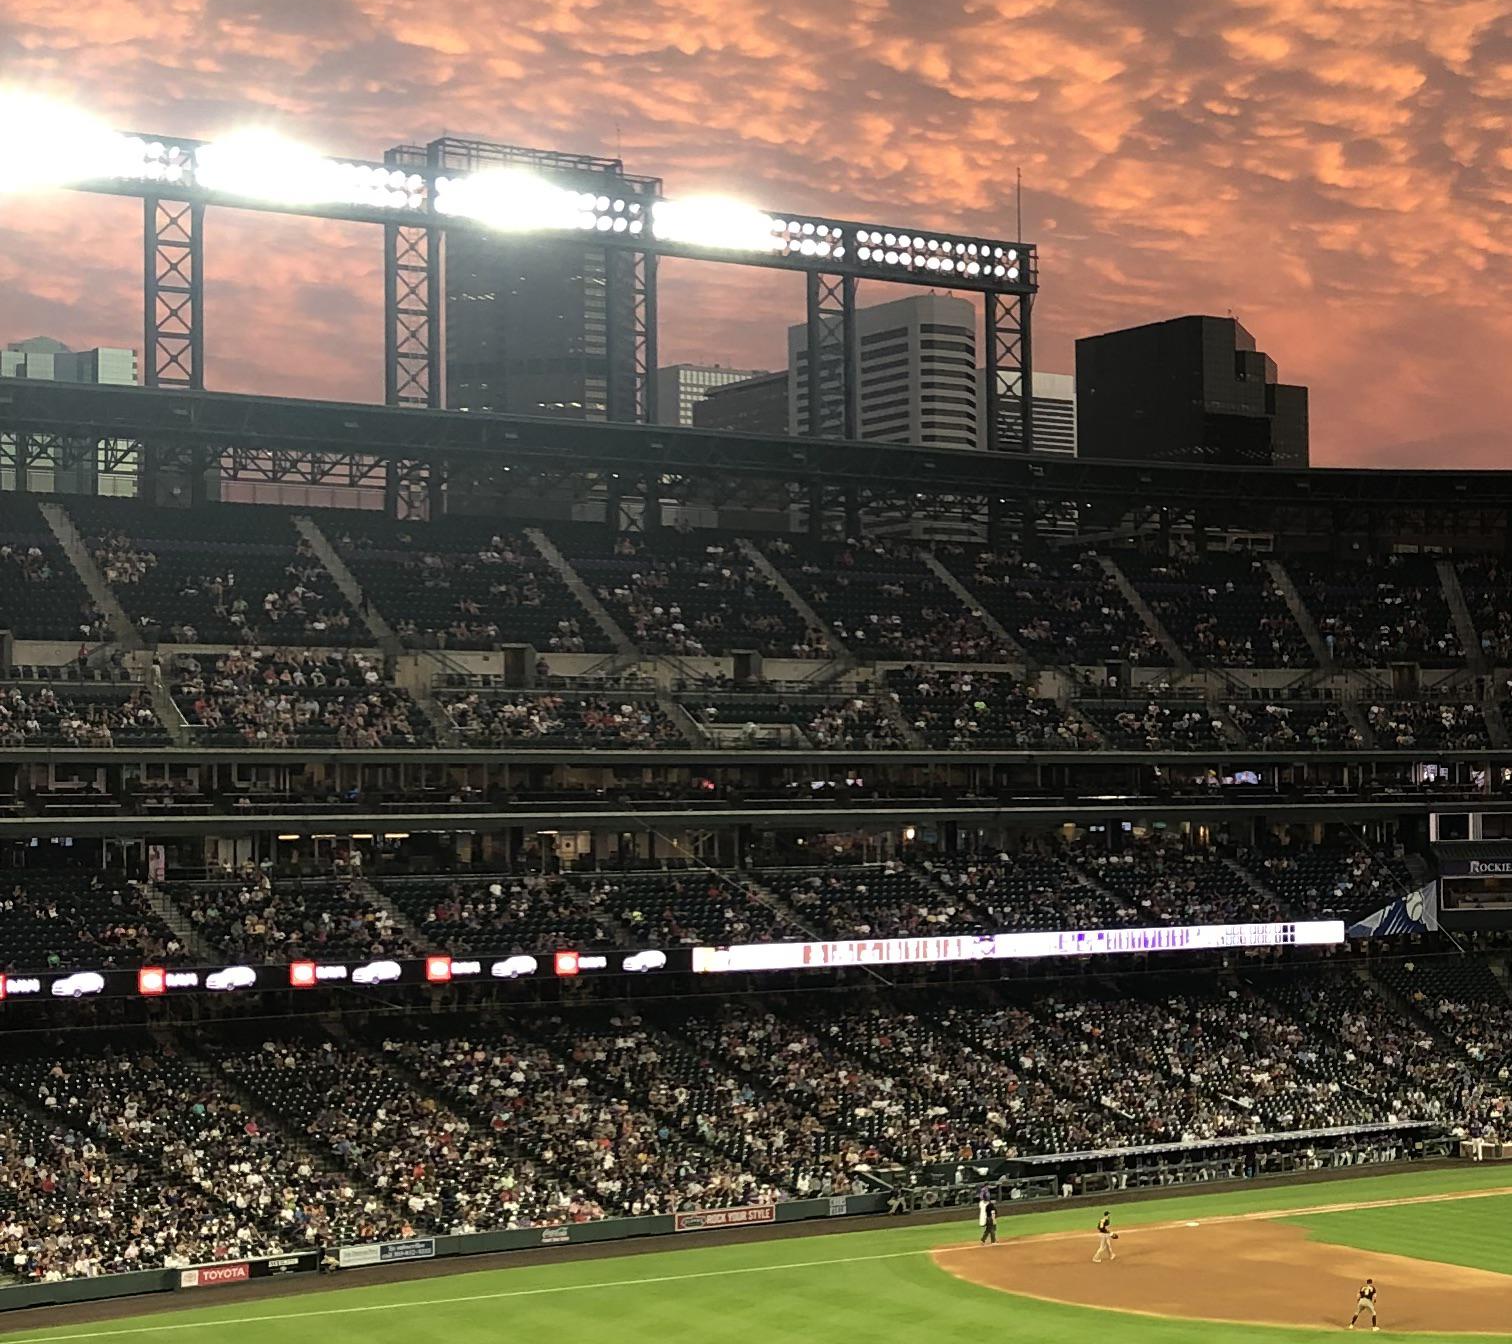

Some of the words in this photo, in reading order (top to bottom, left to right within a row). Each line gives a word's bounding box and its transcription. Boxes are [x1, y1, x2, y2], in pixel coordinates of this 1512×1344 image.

[707, 1214, 727, 1224] ROCK
[728, 1211, 748, 1222] YOUR
[748, 1208, 771, 1221] STYLE
[202, 1267, 246, 1281] TOYOTA
